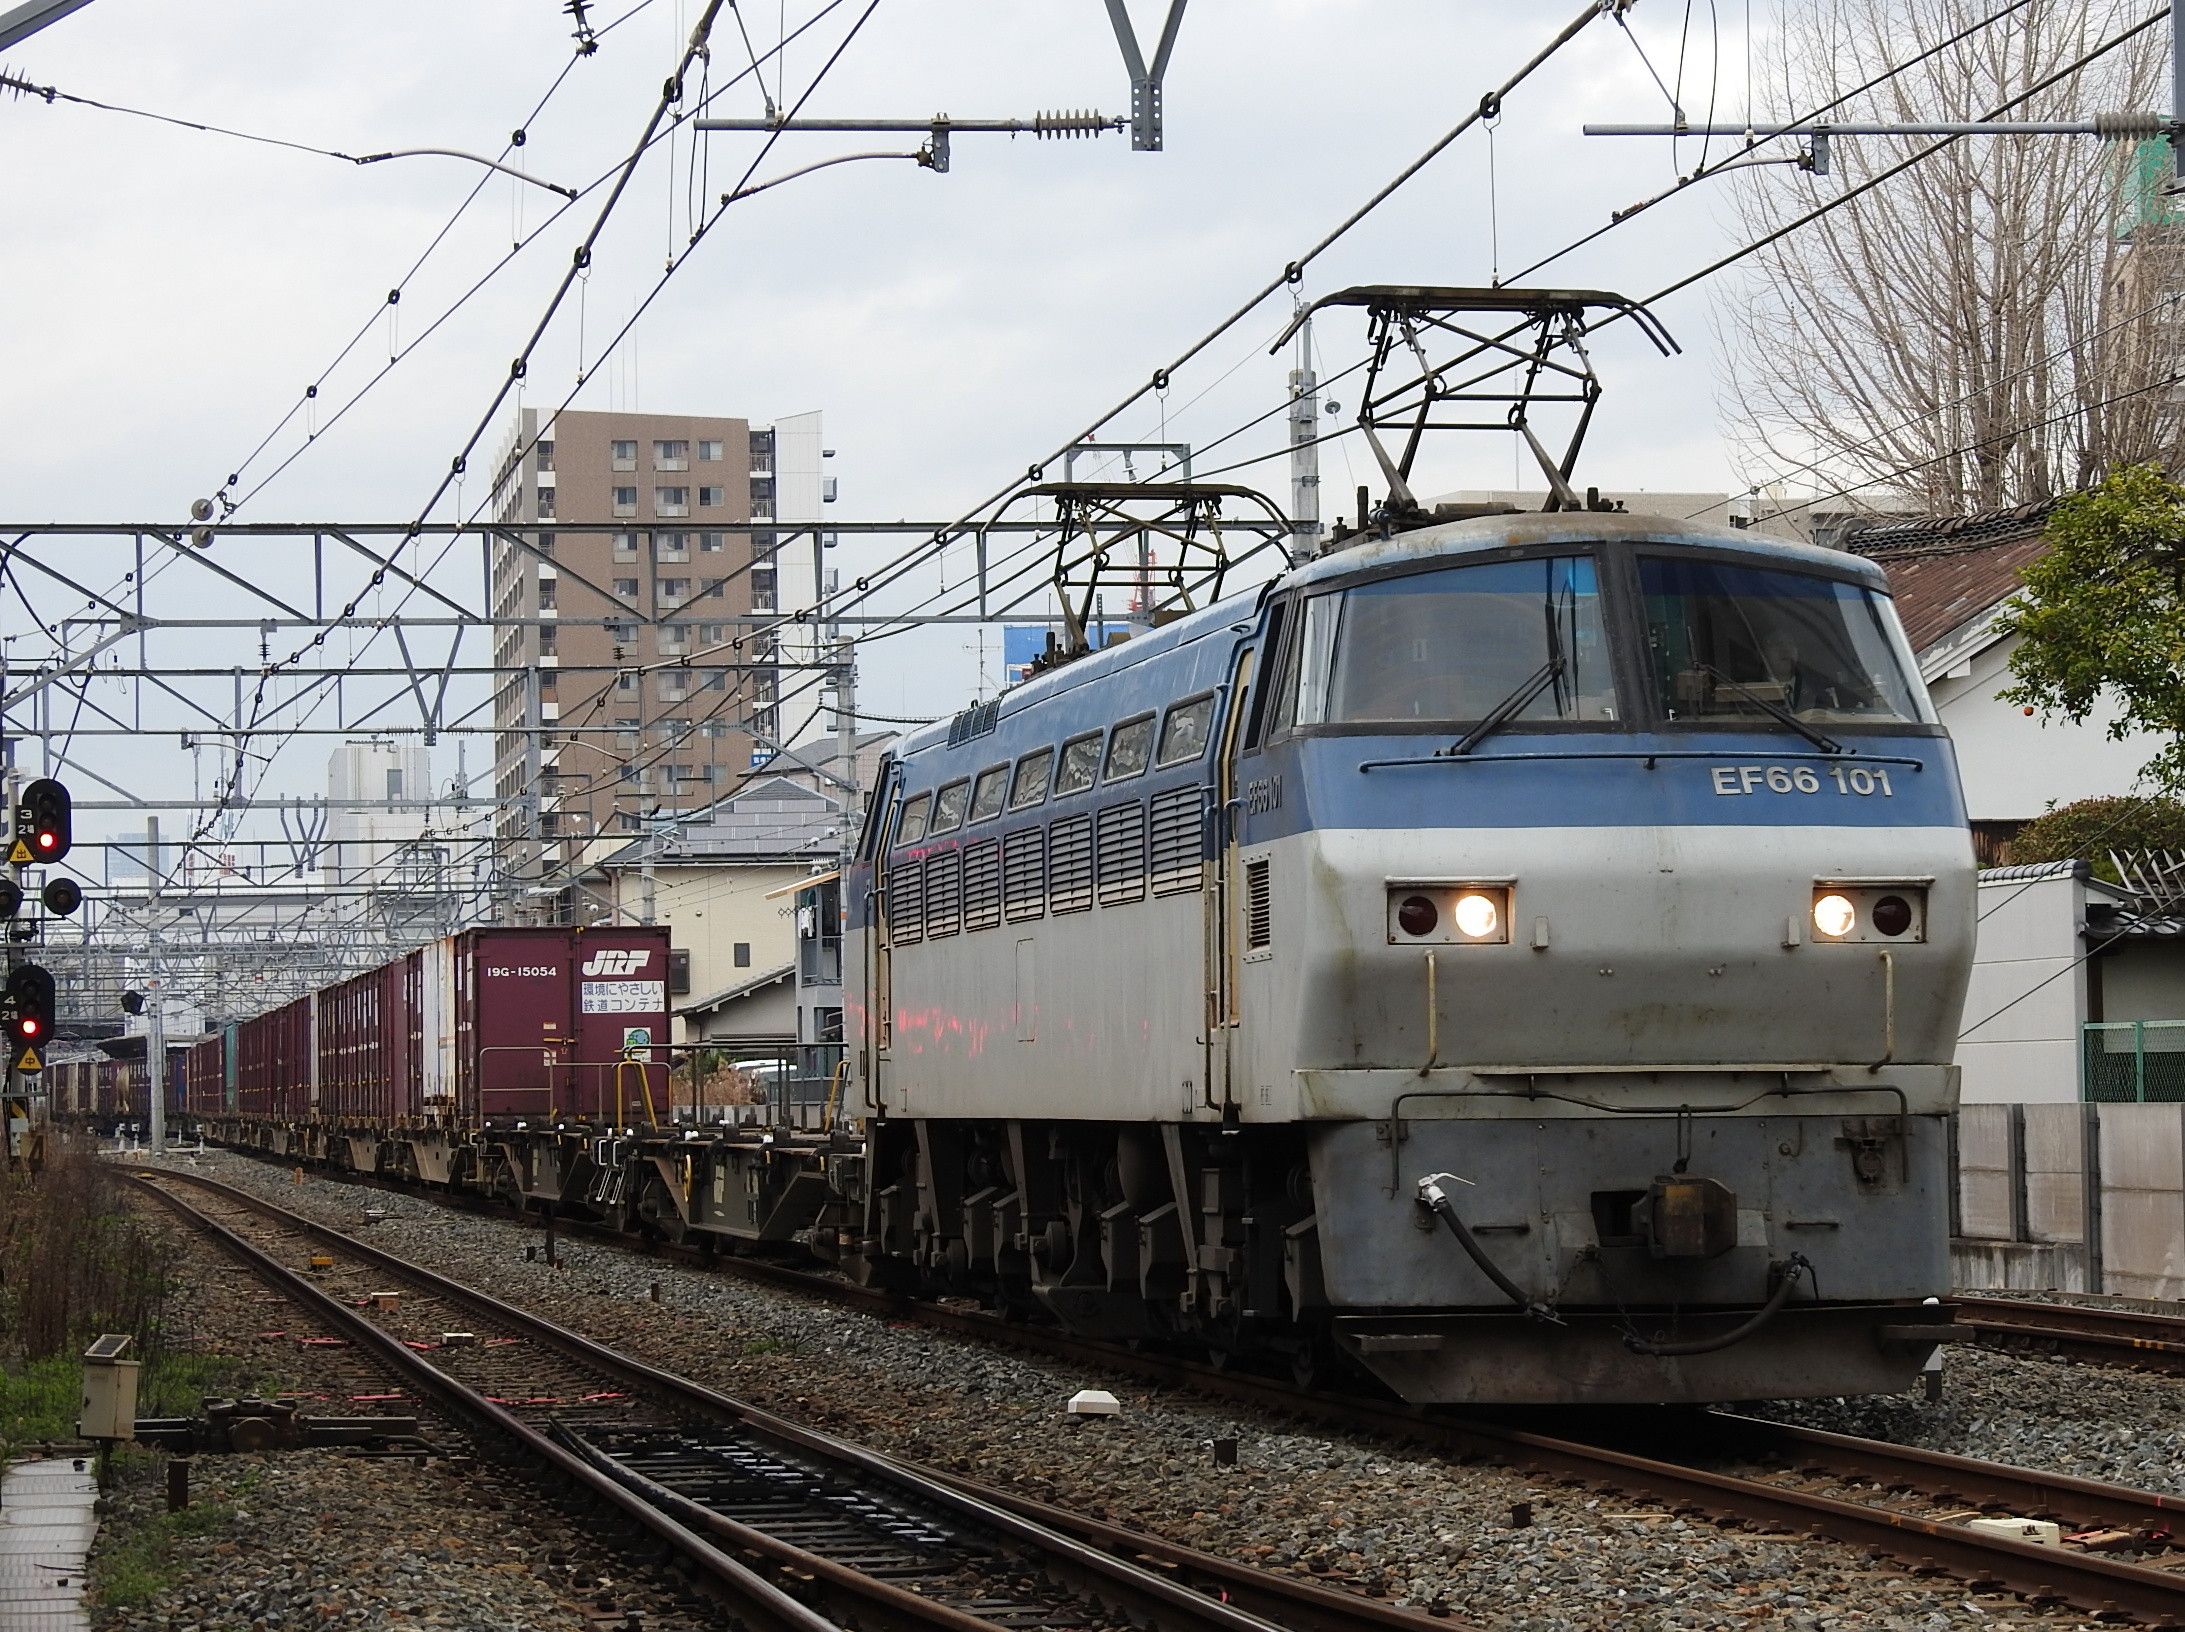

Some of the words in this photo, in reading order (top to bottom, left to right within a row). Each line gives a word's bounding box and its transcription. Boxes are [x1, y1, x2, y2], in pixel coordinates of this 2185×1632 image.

[1711, 766, 1820, 796] EF66
[1829, 767, 1893, 797] 101
[20, 809, 33, 819] 3
[582, 950, 651, 976] JRF
[487, 966, 557, 977] 19G-15054
[583, 982, 663, 996] 環境にやさしい
[4, 995, 16, 1005] 4
[583, 998, 663, 1012] 鉄道コンテナ
[25, 1057, 35, 1067] 中
